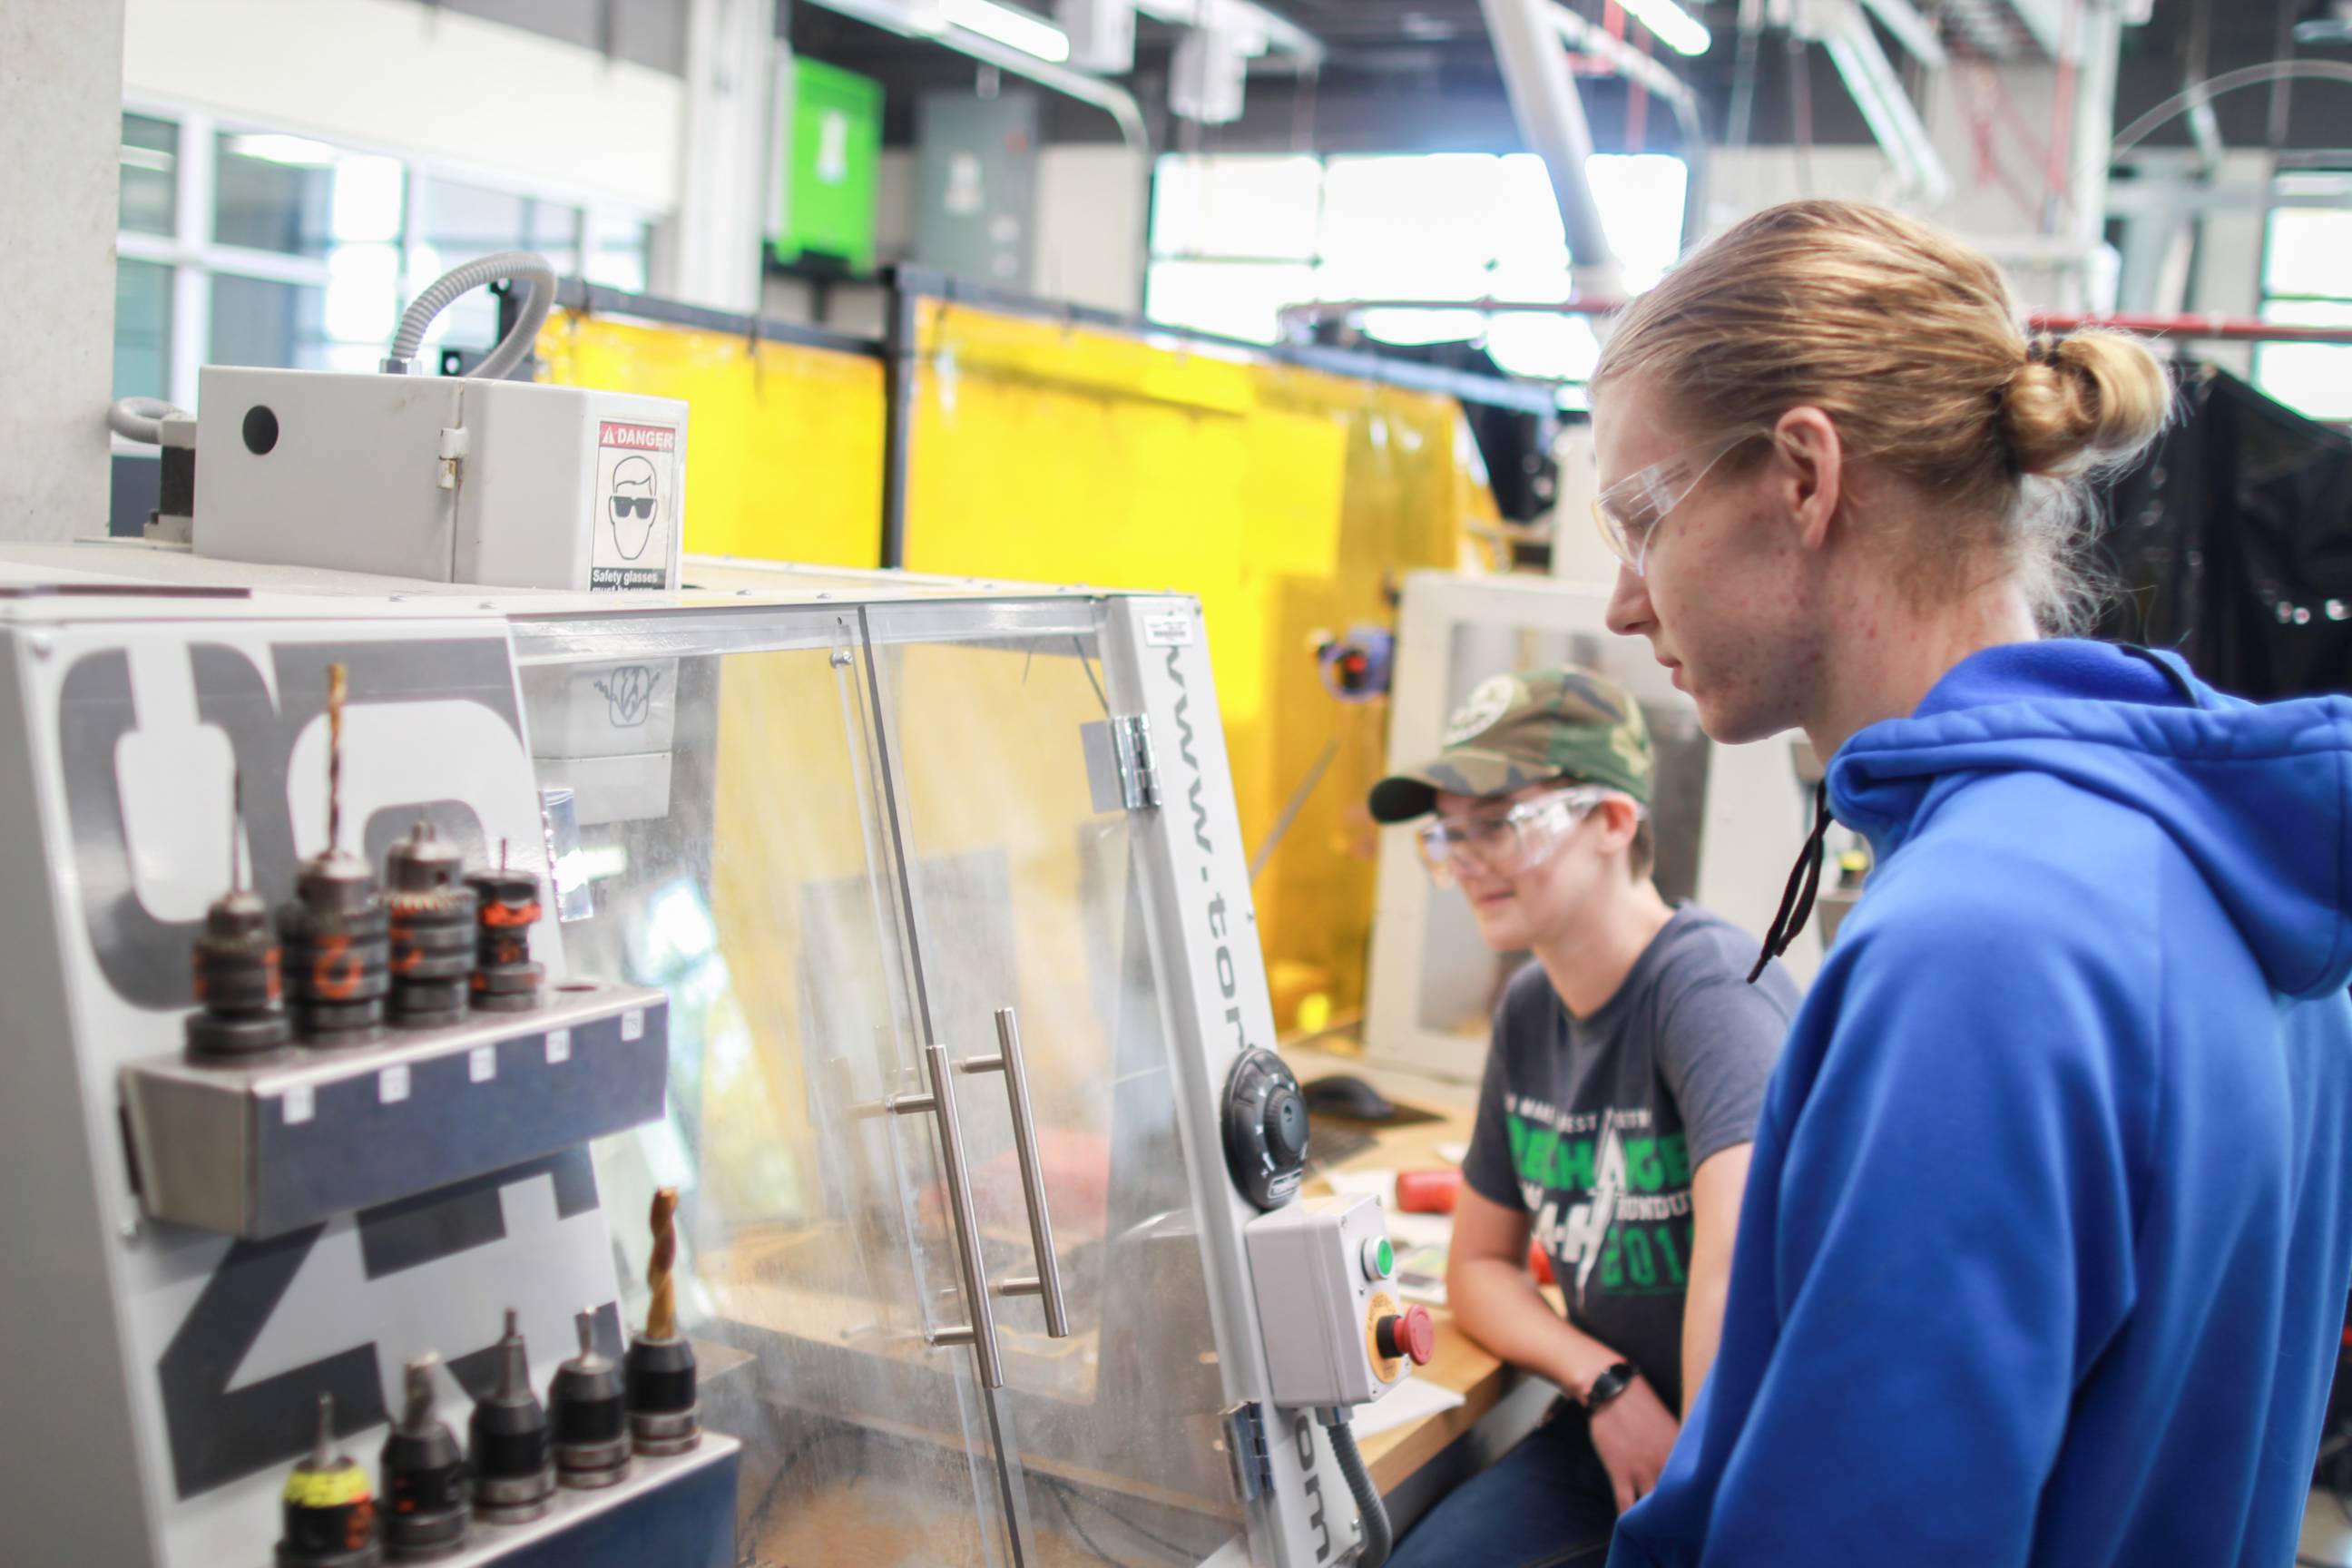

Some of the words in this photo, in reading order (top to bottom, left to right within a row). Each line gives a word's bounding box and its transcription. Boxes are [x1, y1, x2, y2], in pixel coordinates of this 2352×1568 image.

[617, 428, 673, 449] DANGER
[593, 569, 622, 585] Safety
[623, 570, 658, 586] glasses
[1601, 1223, 1693, 1287] 201
